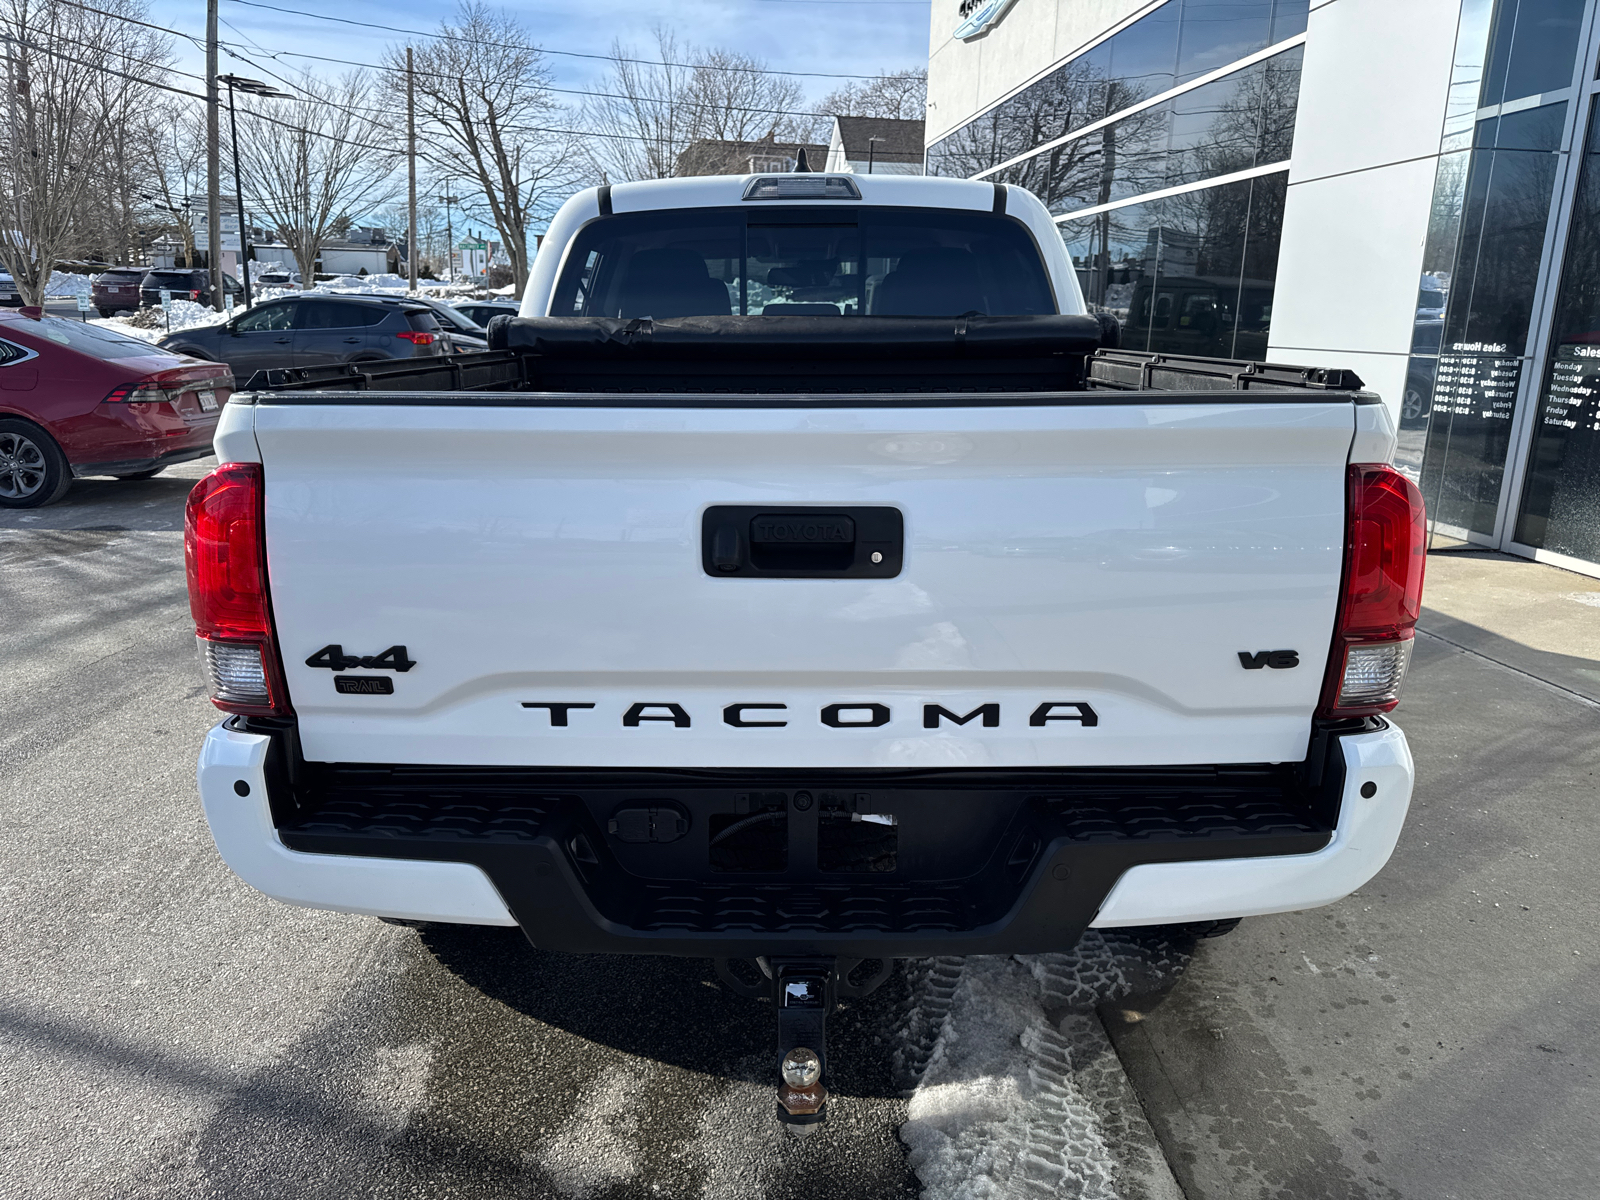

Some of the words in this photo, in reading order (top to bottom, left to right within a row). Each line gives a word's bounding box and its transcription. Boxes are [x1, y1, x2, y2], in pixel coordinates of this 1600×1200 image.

[1573, 346, 1600, 357] Sales
[1554, 361, 1583, 372] Monday
[1552, 373, 1583, 384] Tuesday
[1550, 383, 1592, 396] Wednesday
[1548, 395, 1582, 407] Thursday
[1546, 406, 1568, 416] Friday
[1544, 416, 1577, 429] Saturday
[759, 523, 846, 540] TOYOTA
[305, 644, 417, 672] 4x4
[1237, 650, 1300, 669] V6
[339, 679, 387, 693] TRAIL
[521, 702, 1099, 728] TACOMA
